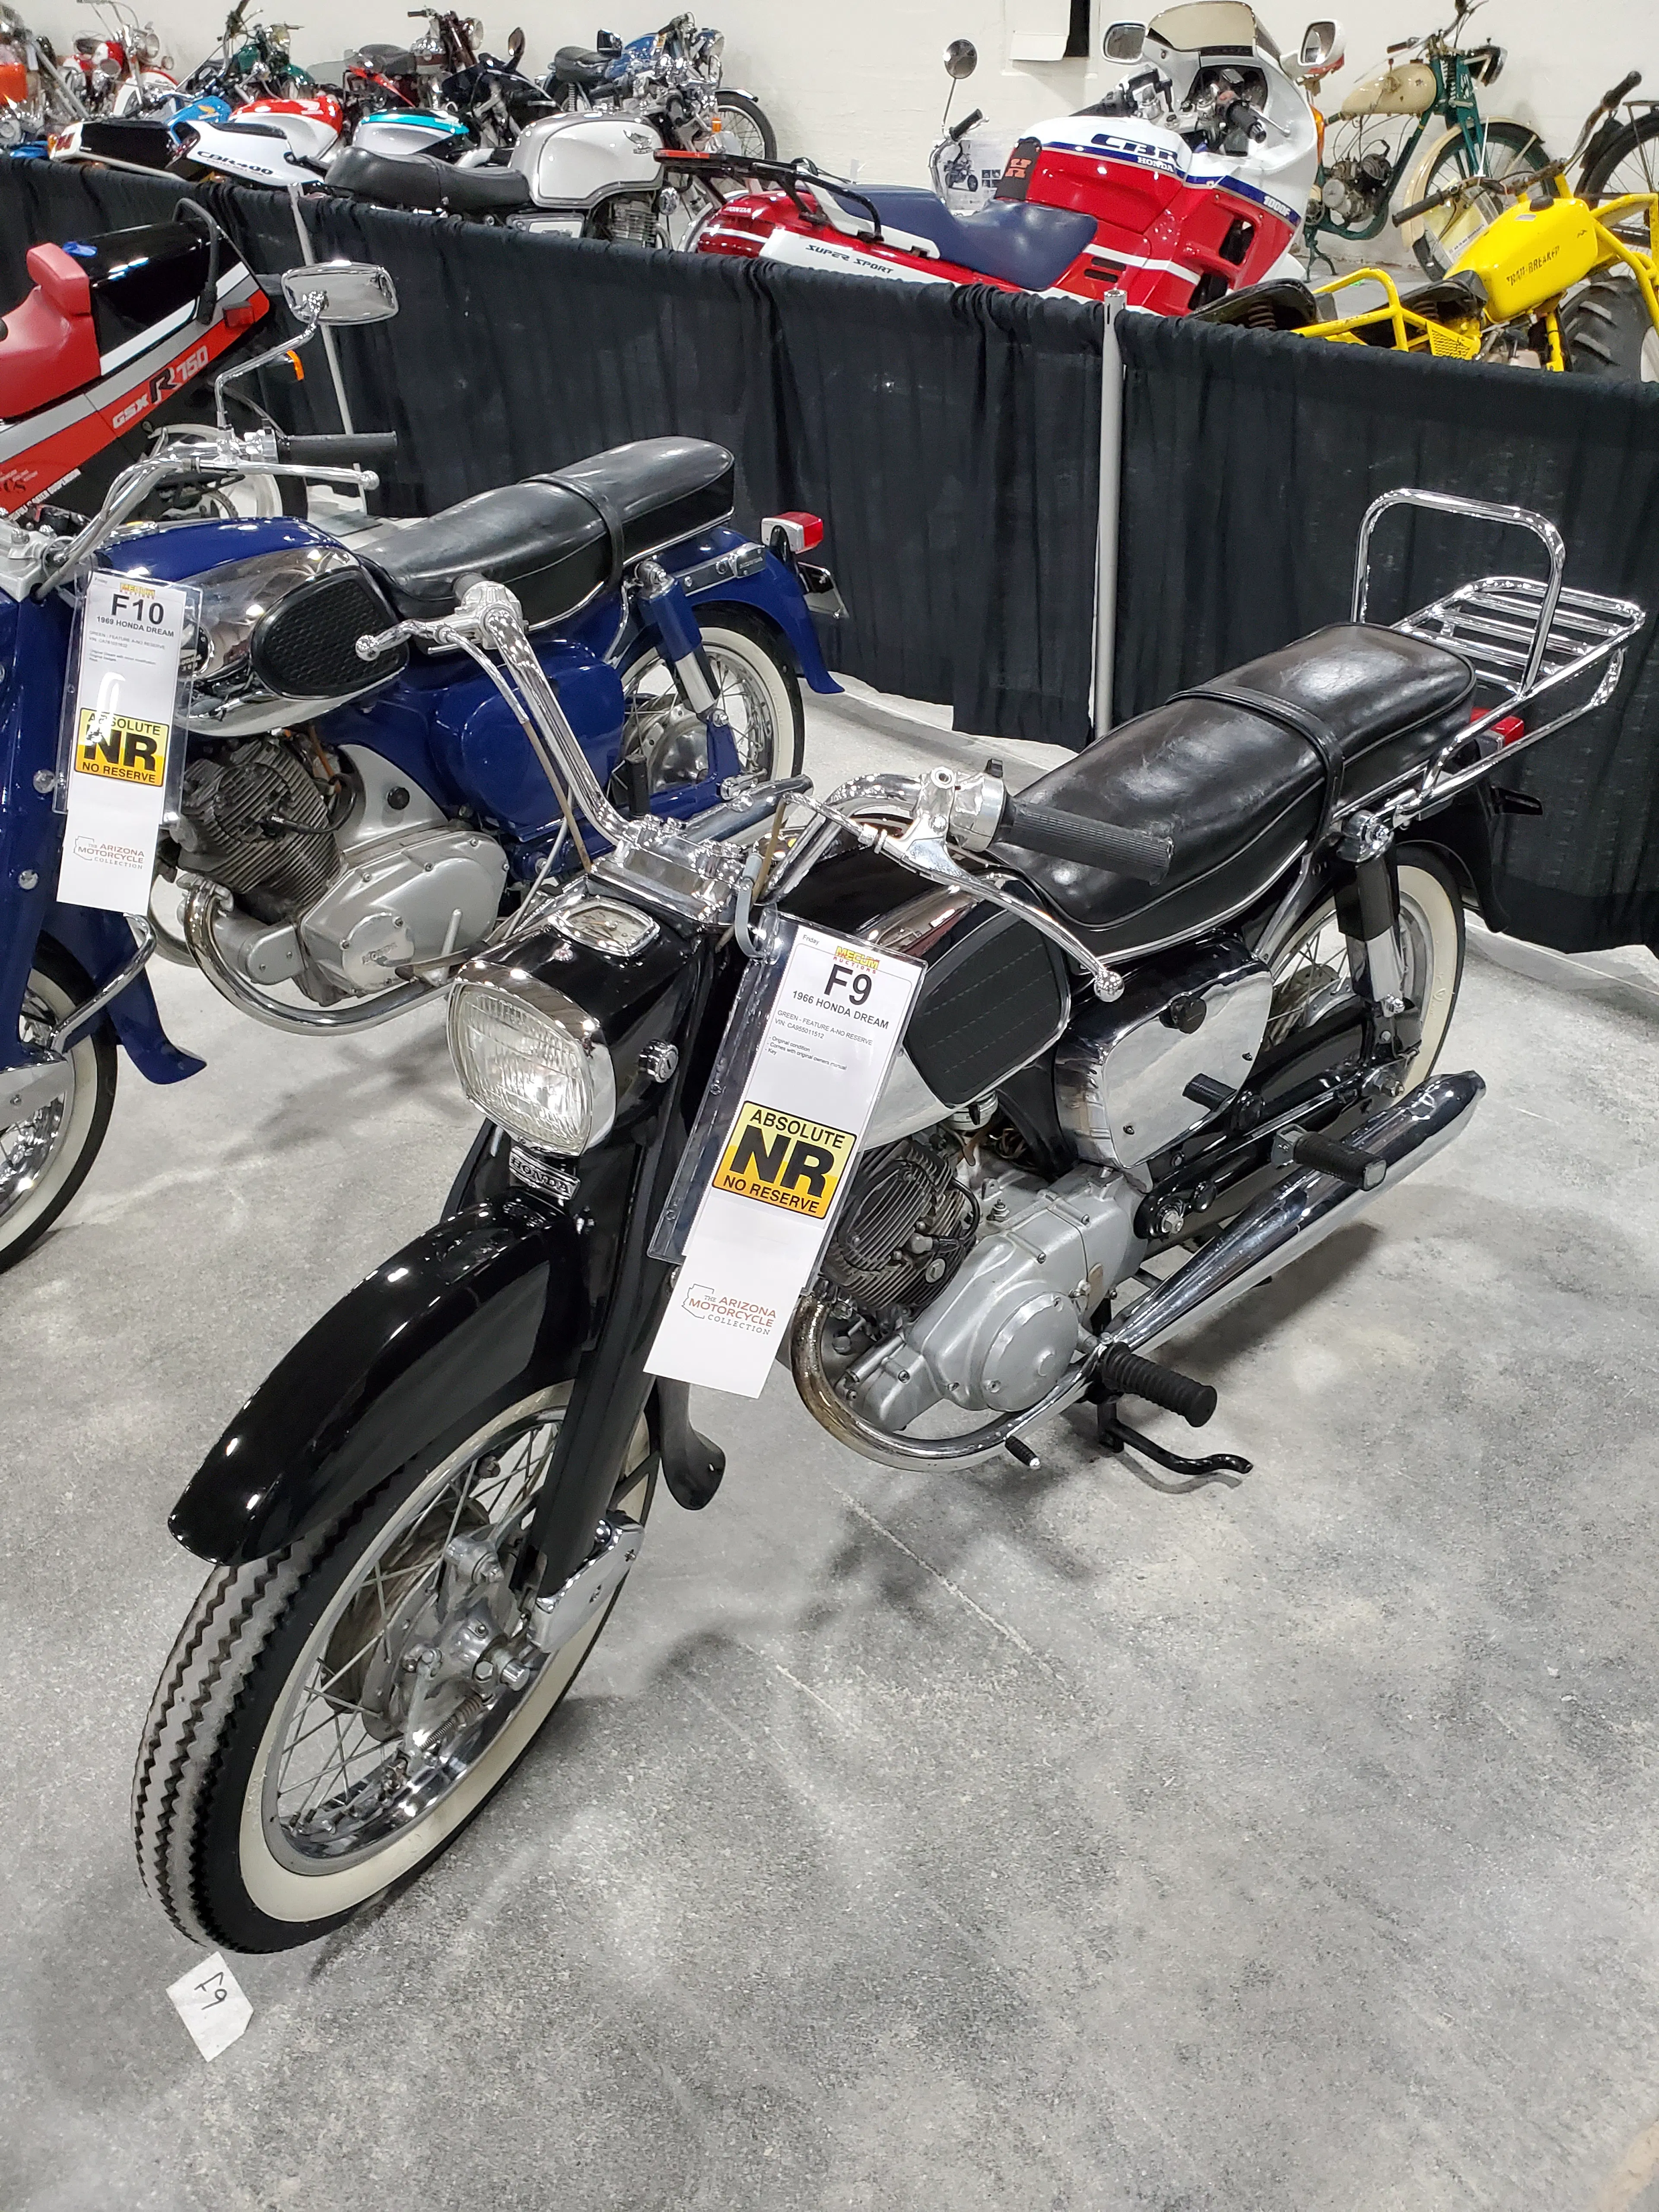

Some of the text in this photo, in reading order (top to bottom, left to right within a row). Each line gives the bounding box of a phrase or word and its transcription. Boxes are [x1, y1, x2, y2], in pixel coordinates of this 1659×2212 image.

[1091, 133, 1182, 168] CBR
[1137, 157, 1174, 172] HONDA
[1263, 196, 1291, 216] 1000F
[805, 245, 894, 274] SUPER SPORT
[112, 393, 149, 429] GSX
[176, 345, 209, 381] 750
[111, 593, 164, 624] F10
[97, 616, 174, 637] 1969 HONDA DREAM
[88, 712, 161, 735] ASOLUTE
[84, 724, 158, 772] NR
[83, 762, 156, 783] NO RESERVE
[78, 846, 144, 864] MOTORCYCLE
[100, 844, 145, 857] ARIZONA
[94, 857, 143, 870] COLLECTION
[802, 934, 820, 945] Friday
[833, 956, 876, 974] AUCTIONS
[835, 946, 880, 970] MECUM
[824, 964, 872, 1005] F9
[793, 991, 889, 1030] 1966 HONDA DREAM
[775, 1018, 786, 1027] VIN:
[778, 1010, 799, 1021] GREEN
[803, 1018, 830, 1032] FEATURE
[830, 1028, 845, 1036] A-NO
[846, 1033, 873, 1046] RESERVE
[770, 1042, 786, 1051] Comes
[797, 1051, 813, 1060] original
[772, 1036, 789, 1045] Original
[790, 1042, 810, 1052] condition
[750, 1109, 845, 1149] ABSOLUTE
[729, 1125, 834, 1198] NR
[510, 1157, 572, 1195] HONDA
[723, 1175, 820, 1213] NO RESERVE
[689, 1298, 774, 1328] MOTORCYCLE
[718, 1297, 776, 1319] ARIZONA
[708, 1314, 770, 1335] COLLECTION
